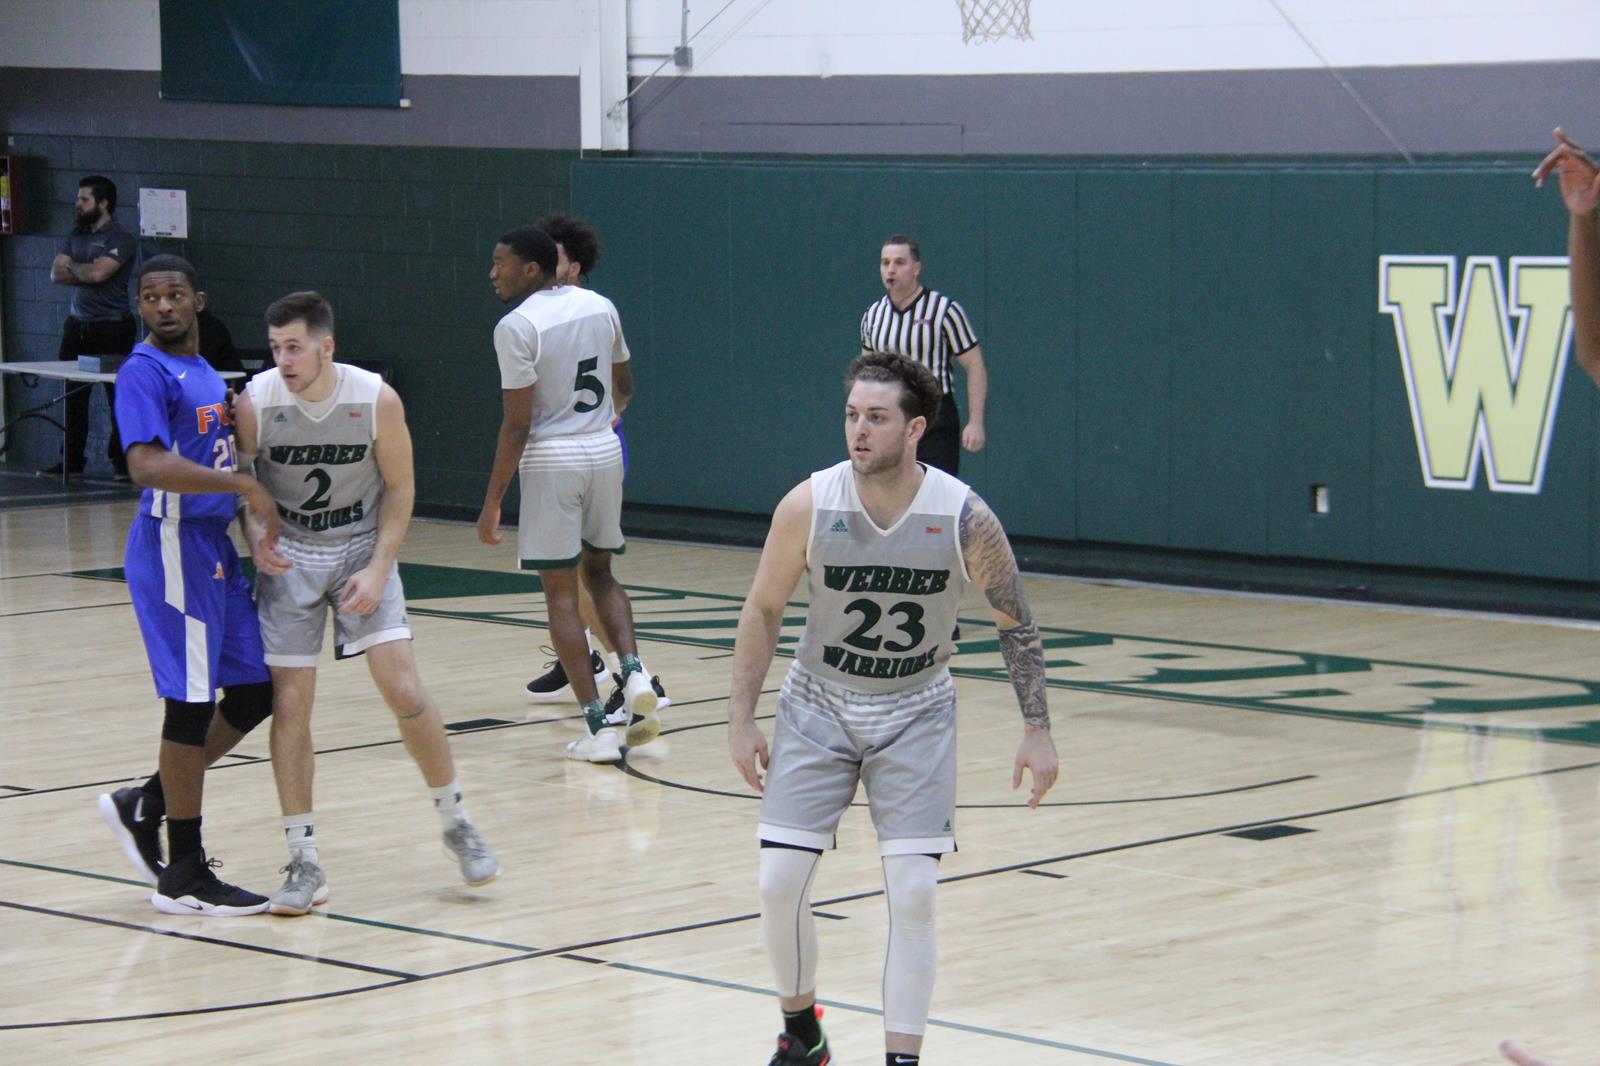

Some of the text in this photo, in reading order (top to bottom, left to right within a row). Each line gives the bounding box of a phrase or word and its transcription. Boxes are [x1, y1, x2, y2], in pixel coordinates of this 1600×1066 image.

[573, 355, 605, 413] 5
[1378, 255, 1575, 494] W
[269, 443, 368, 466] WEBBER
[300, 467, 332, 511] 2
[823, 564, 951, 596] WEBBER
[842, 598, 926, 653] 23
[822, 644, 940, 679] WARRIORS
